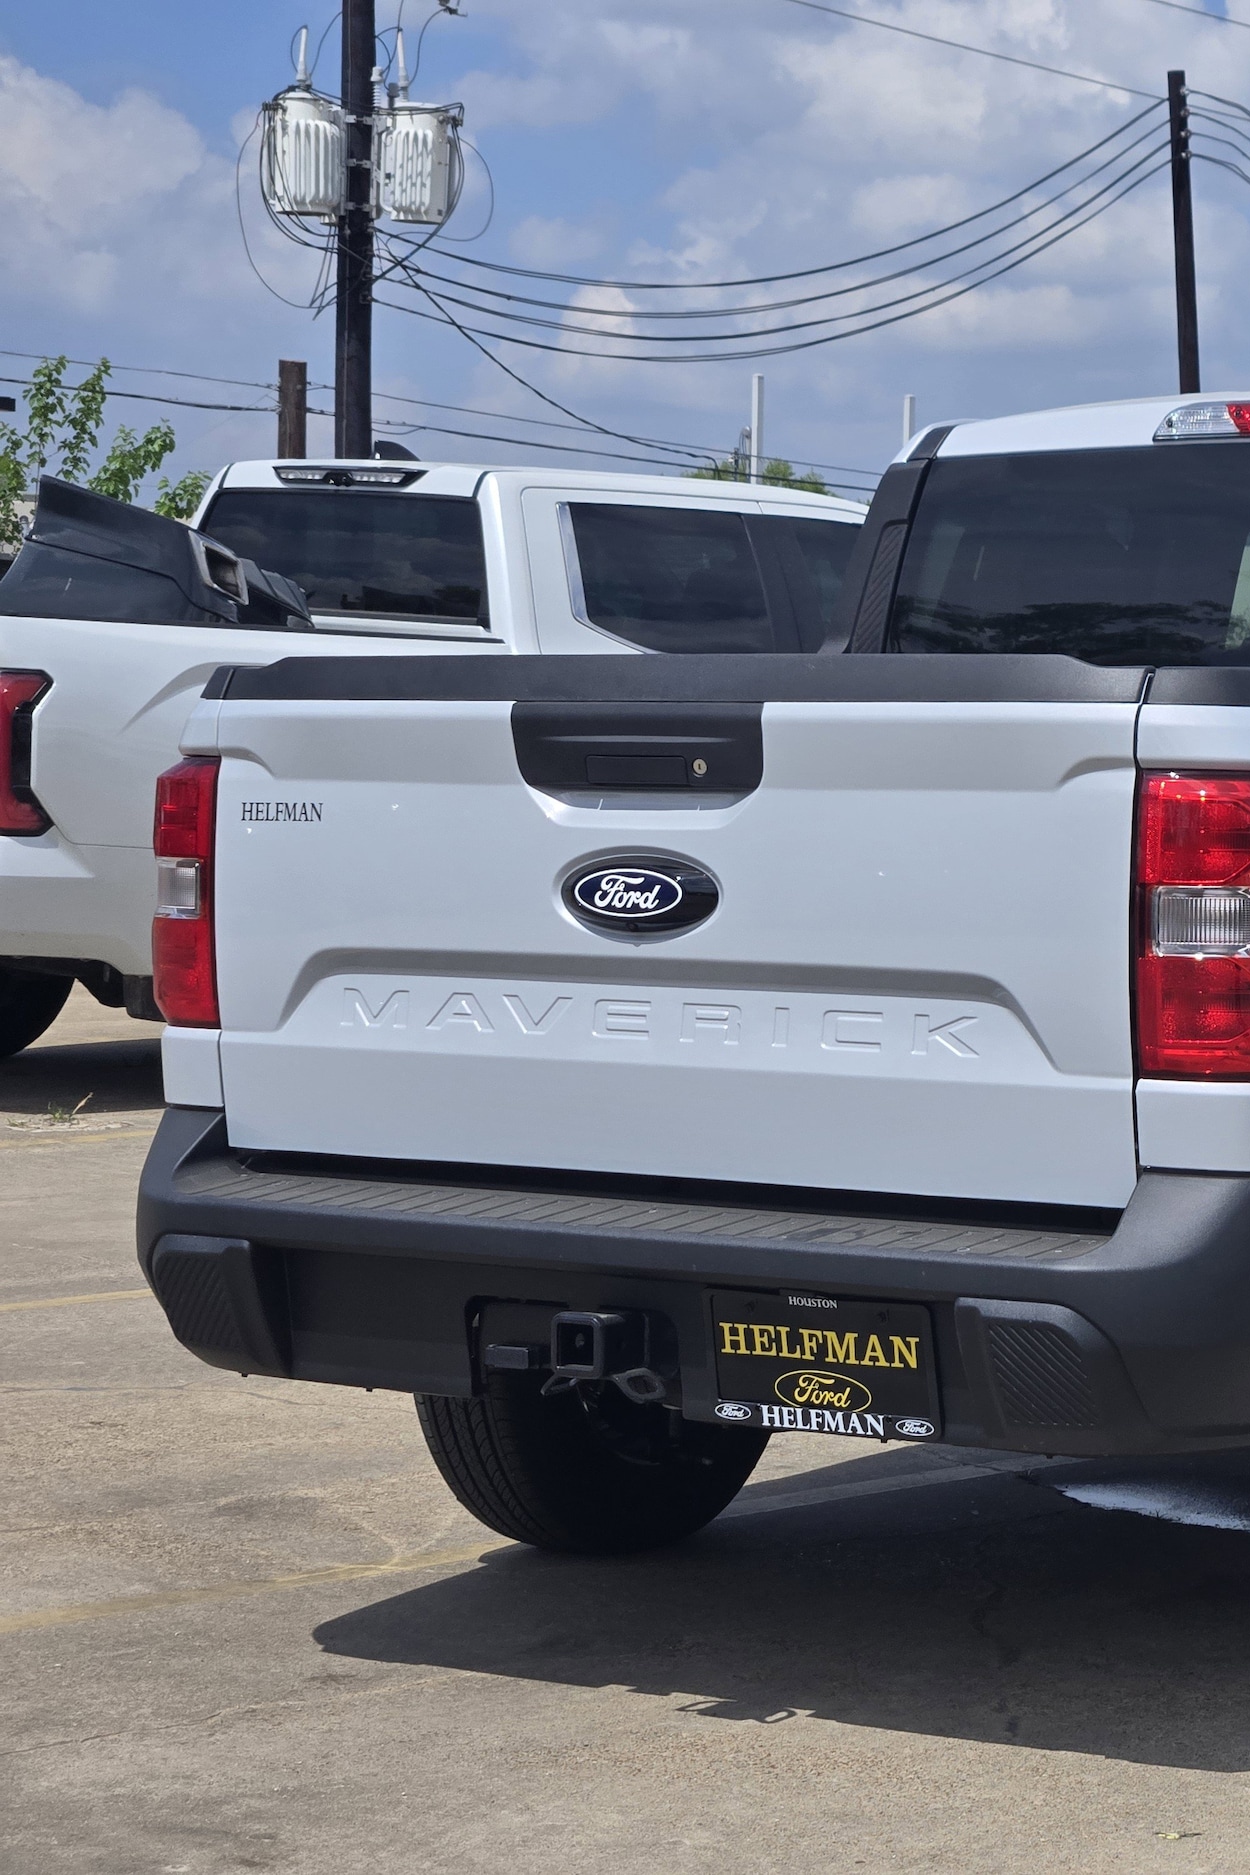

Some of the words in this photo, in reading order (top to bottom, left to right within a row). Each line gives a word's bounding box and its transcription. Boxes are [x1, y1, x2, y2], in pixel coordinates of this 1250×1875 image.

[241, 802, 323, 822] HELFMAN
[594, 874, 661, 909] Ford
[340, 987, 982, 1058] MAVERICK
[788, 1296, 838, 1309] HOUSTON
[719, 1322, 920, 1369] HELFMAN
[794, 1374, 852, 1408] Ford
[721, 1406, 745, 1418] Ford
[760, 1404, 884, 1436] HELFMAN
[903, 1422, 928, 1434] Ford
